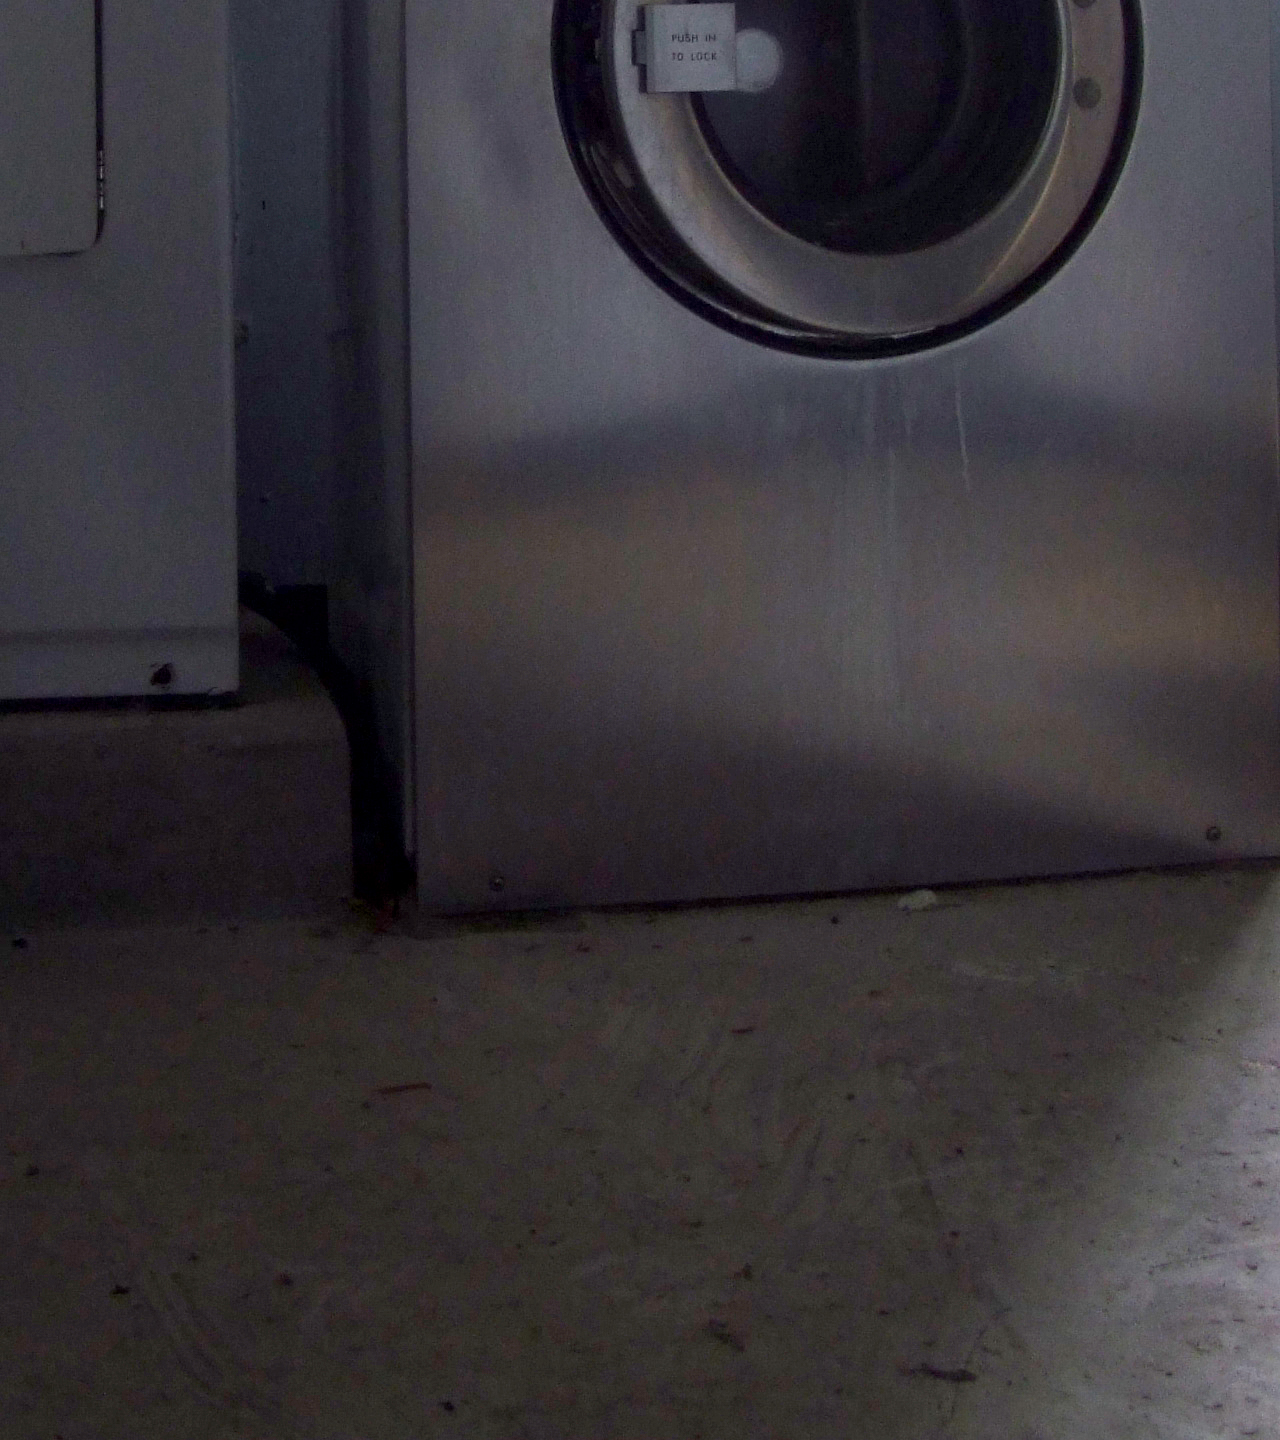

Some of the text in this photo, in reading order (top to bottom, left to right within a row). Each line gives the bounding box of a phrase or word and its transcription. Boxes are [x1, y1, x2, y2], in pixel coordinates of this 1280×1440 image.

[671, 33, 717, 43] PUSH IN
[671, 51, 718, 62] TO LOCK
